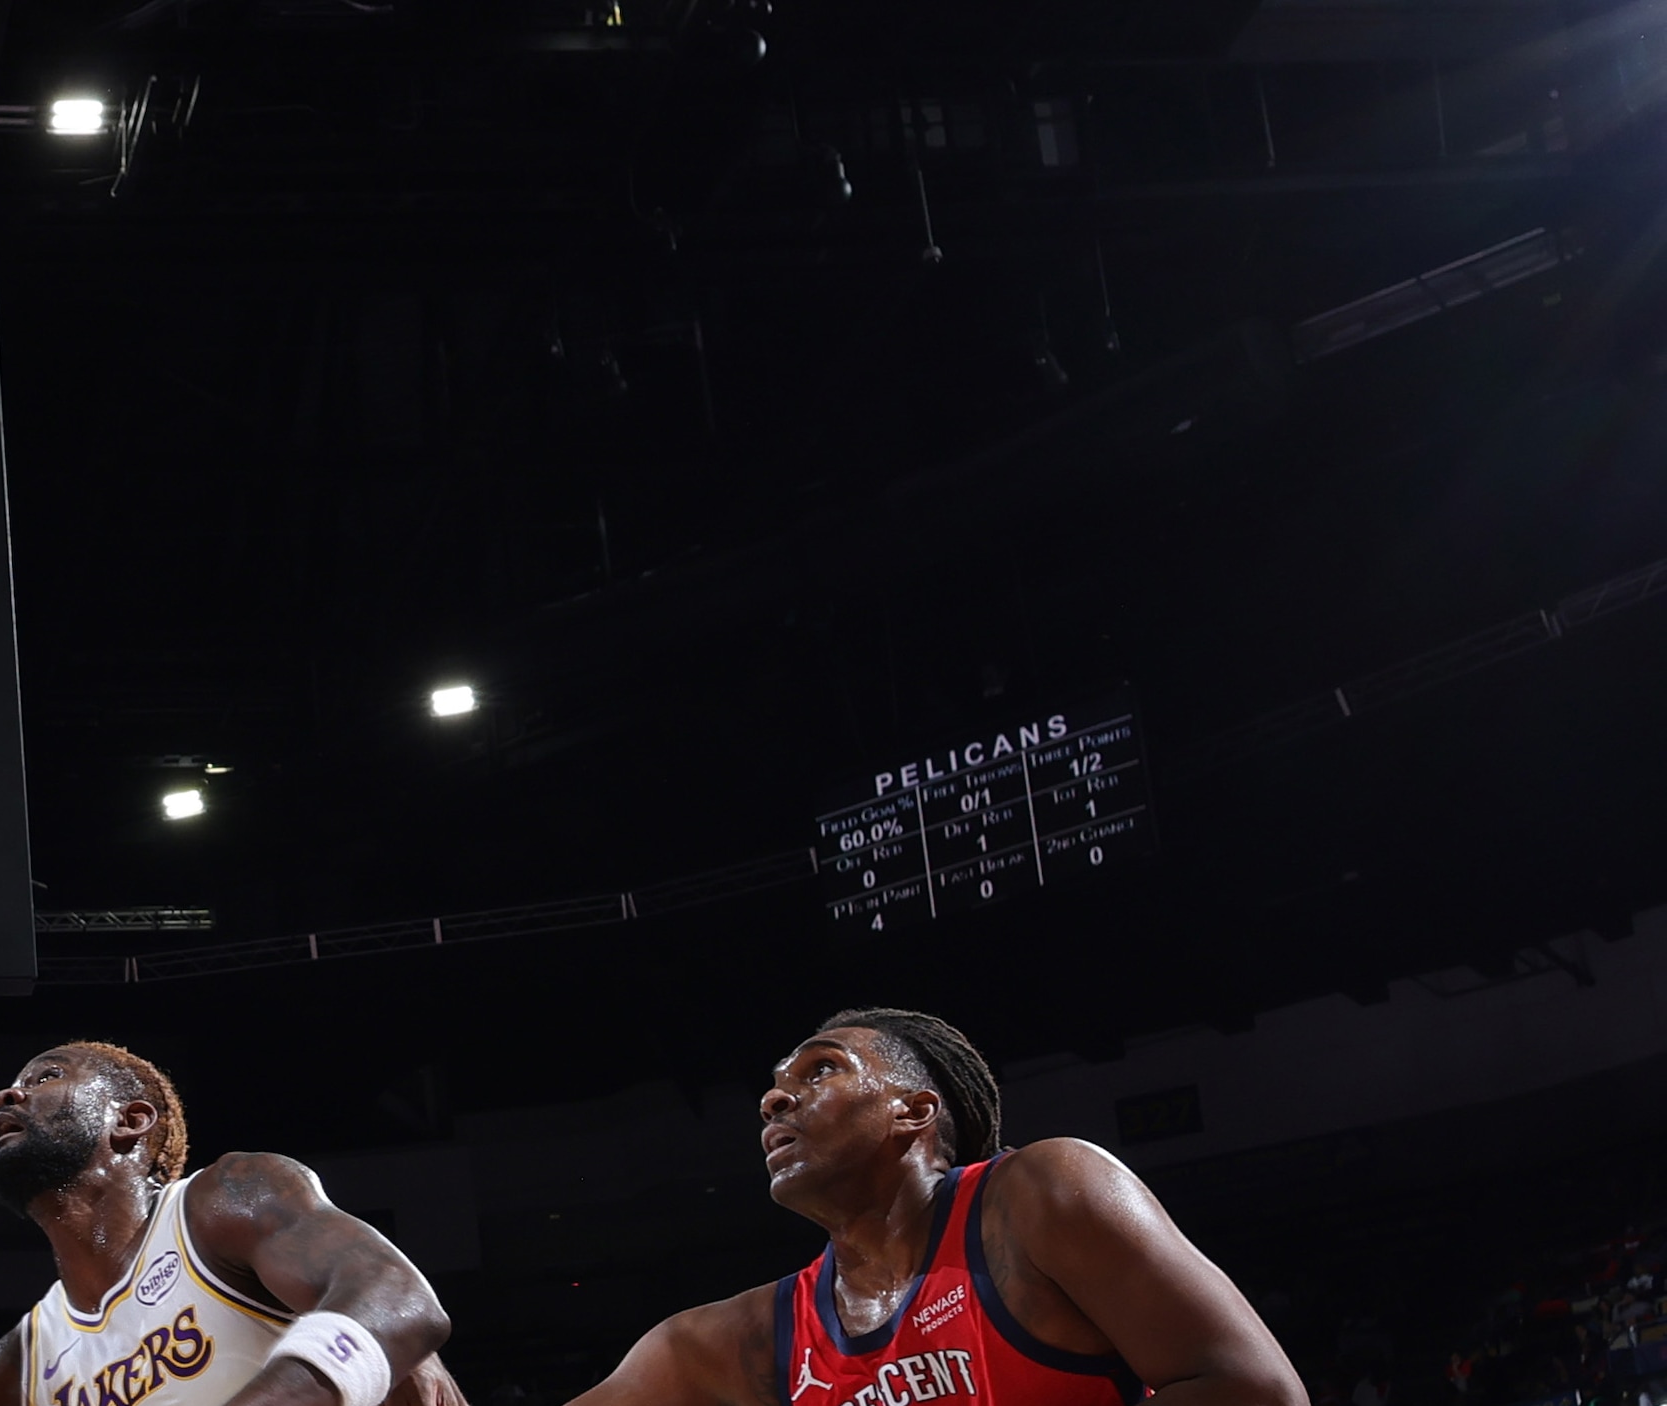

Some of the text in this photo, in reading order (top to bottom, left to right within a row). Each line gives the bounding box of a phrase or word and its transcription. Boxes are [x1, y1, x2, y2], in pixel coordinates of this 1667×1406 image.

[874, 714, 1067, 797] PELICANS
[1069, 752, 1103, 778] 1/2
[960, 788, 992, 814] 0/1
[1086, 799, 1097, 818] 1
[839, 819, 903, 853] 60.0%
[977, 834, 988, 853] 1
[1089, 846, 1104, 866] 0
[862, 869, 876, 889] 0
[980, 880, 994, 899] 0
[871, 912, 885, 932] 4
[140, 1258, 178, 1296] bibigo
[912, 1285, 965, 1328] NEWAGE
[921, 1304, 964, 1335] PRODUCTS
